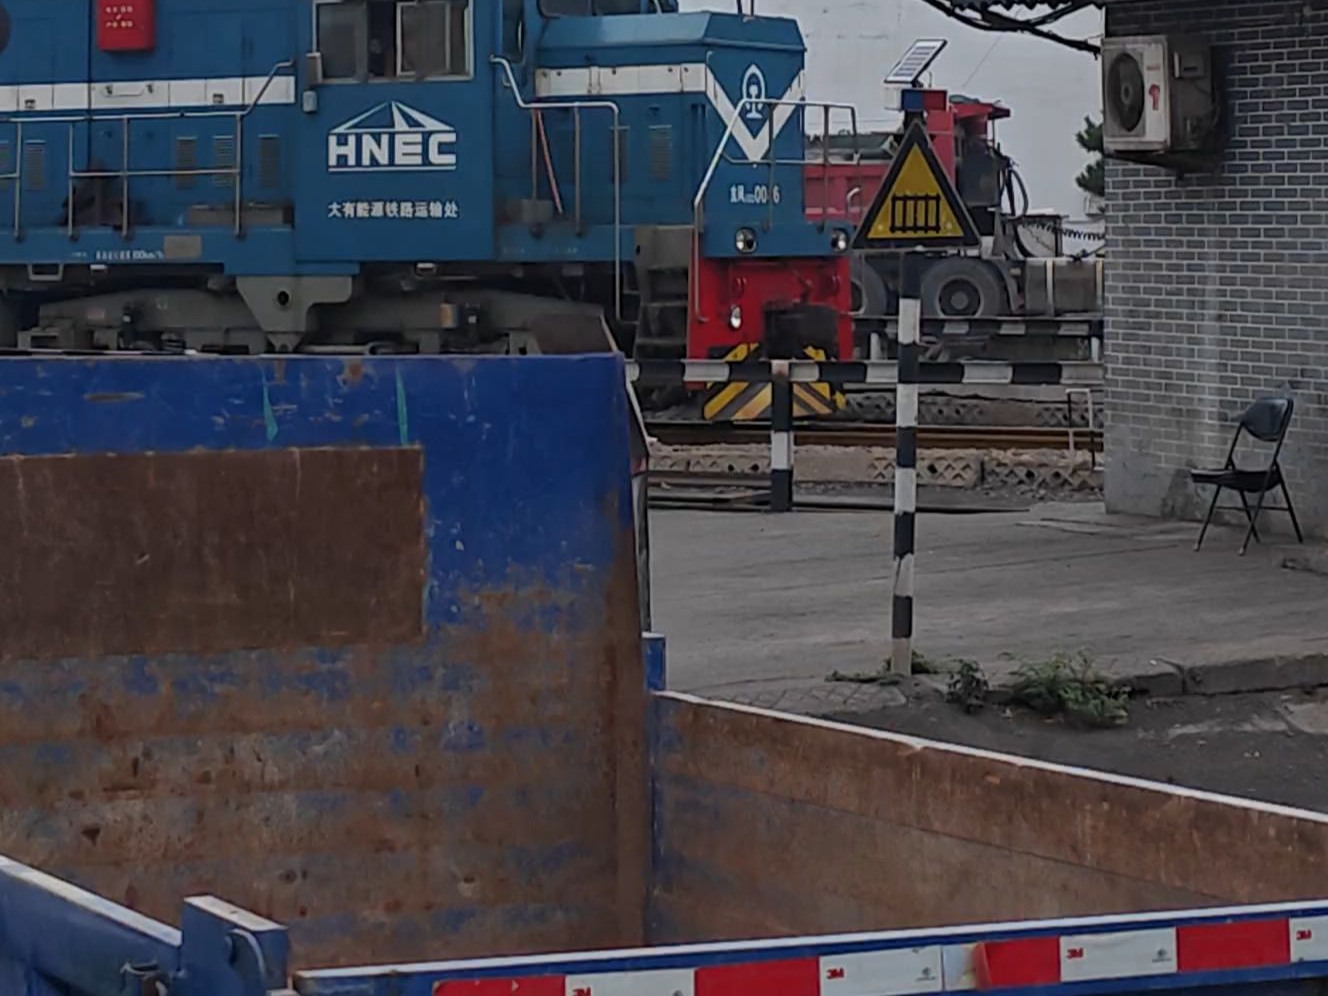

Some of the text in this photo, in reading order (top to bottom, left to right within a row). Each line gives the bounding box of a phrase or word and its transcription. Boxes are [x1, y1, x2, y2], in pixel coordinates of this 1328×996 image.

[328, 132, 457, 166] HNEC
[327, 201, 459, 219] 大有能源铁路运输处
[1296, 929, 1312, 940] 3M
[1066, 947, 1083, 959] 3M
[826, 967, 844, 980] 3M
